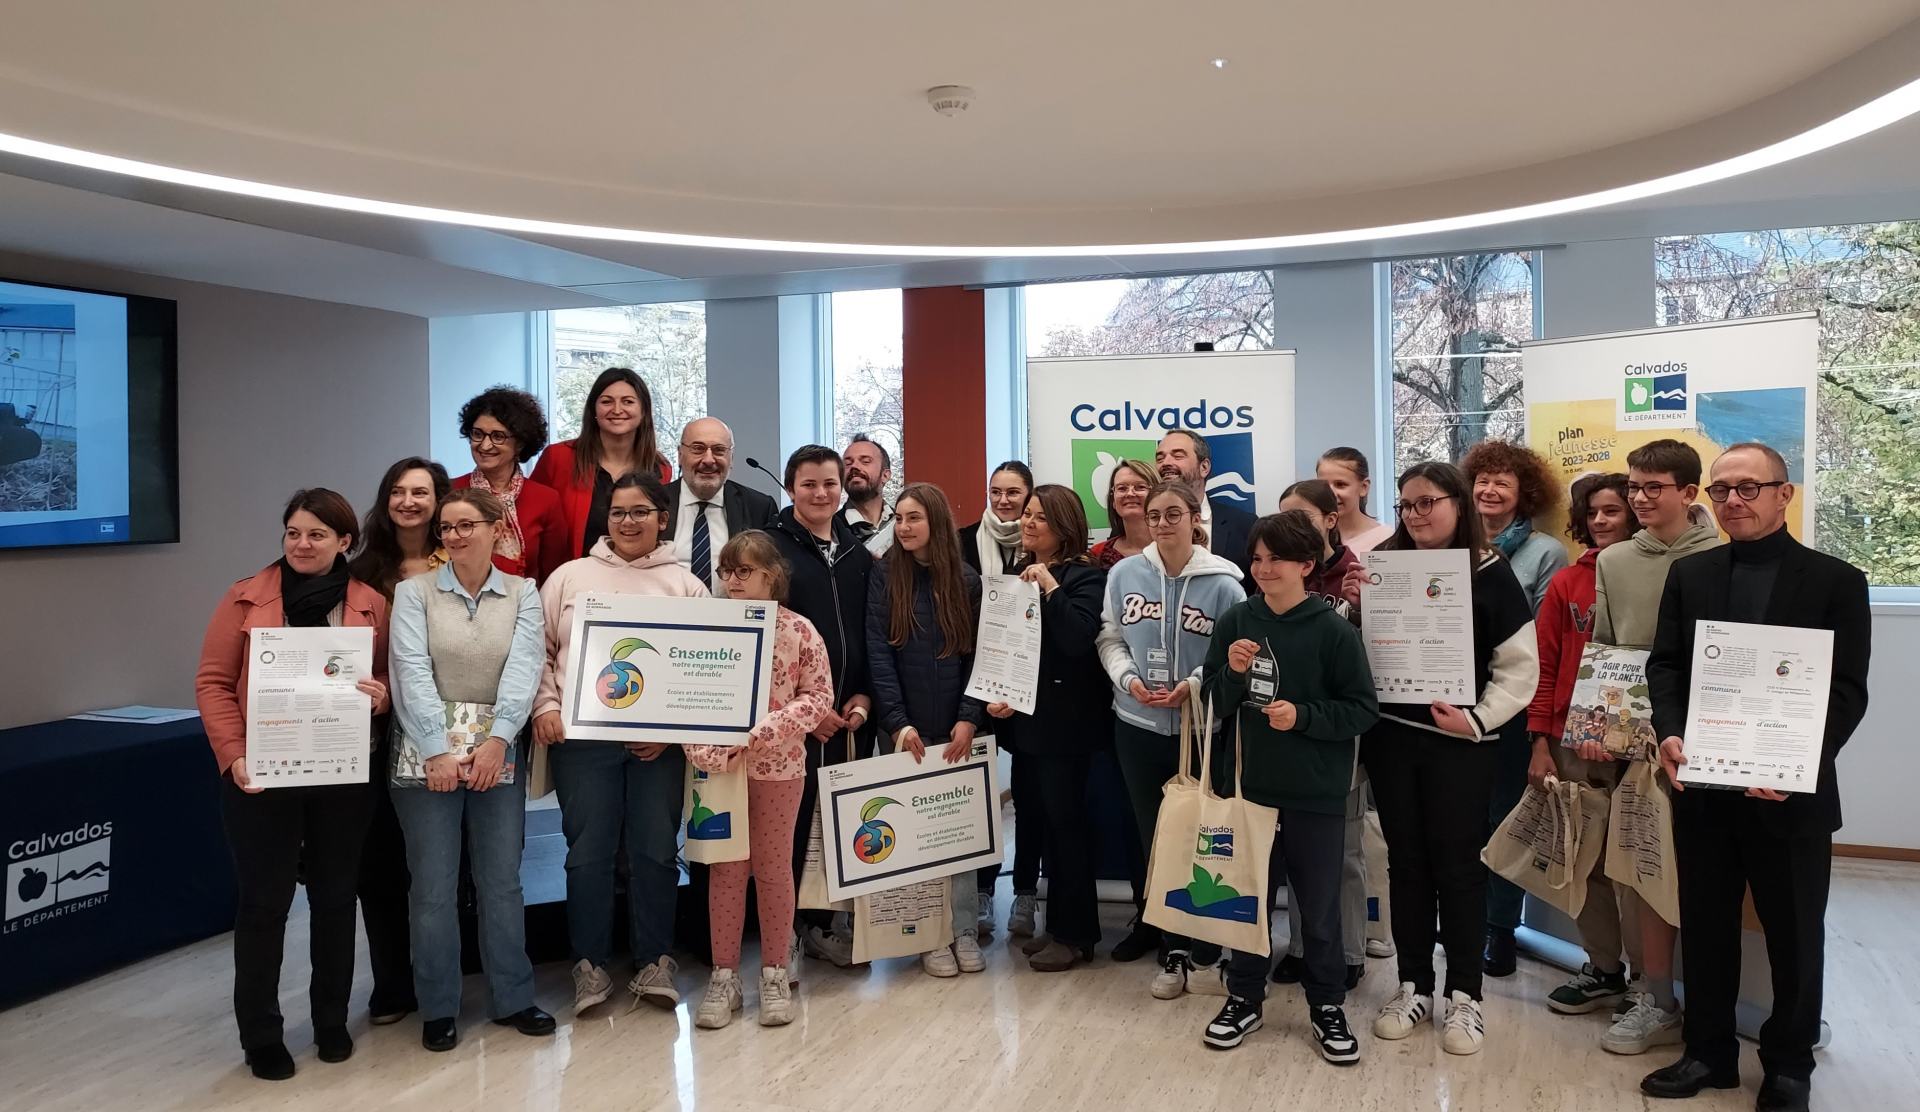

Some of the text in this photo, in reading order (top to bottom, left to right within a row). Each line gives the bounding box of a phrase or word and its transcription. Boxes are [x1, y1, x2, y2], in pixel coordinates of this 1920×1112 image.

[1624, 361, 1688, 376] Calvados
[1071, 399, 1255, 432] Calvados
[1558, 426, 1584, 444] plan
[1562, 450, 1610, 467] 2023-2028
[669, 646, 742, 661] Ensemble
[692, 662, 736, 670] engagement
[1602, 662, 1642, 672] AGIR POUR
[695, 670, 722, 678] durable
[1597, 671, 1607, 680] LA
[1700, 684, 1742, 694] communes
[1697, 717, 1788, 729] engagements d'action
[911, 784, 974, 807] Ensemble
[916, 798, 970, 815] notre engagement
[938, 808, 961, 818] durable
[8, 821, 113, 859] Calvados
[3, 894, 110, 934] LE DÉPARTEMENT
